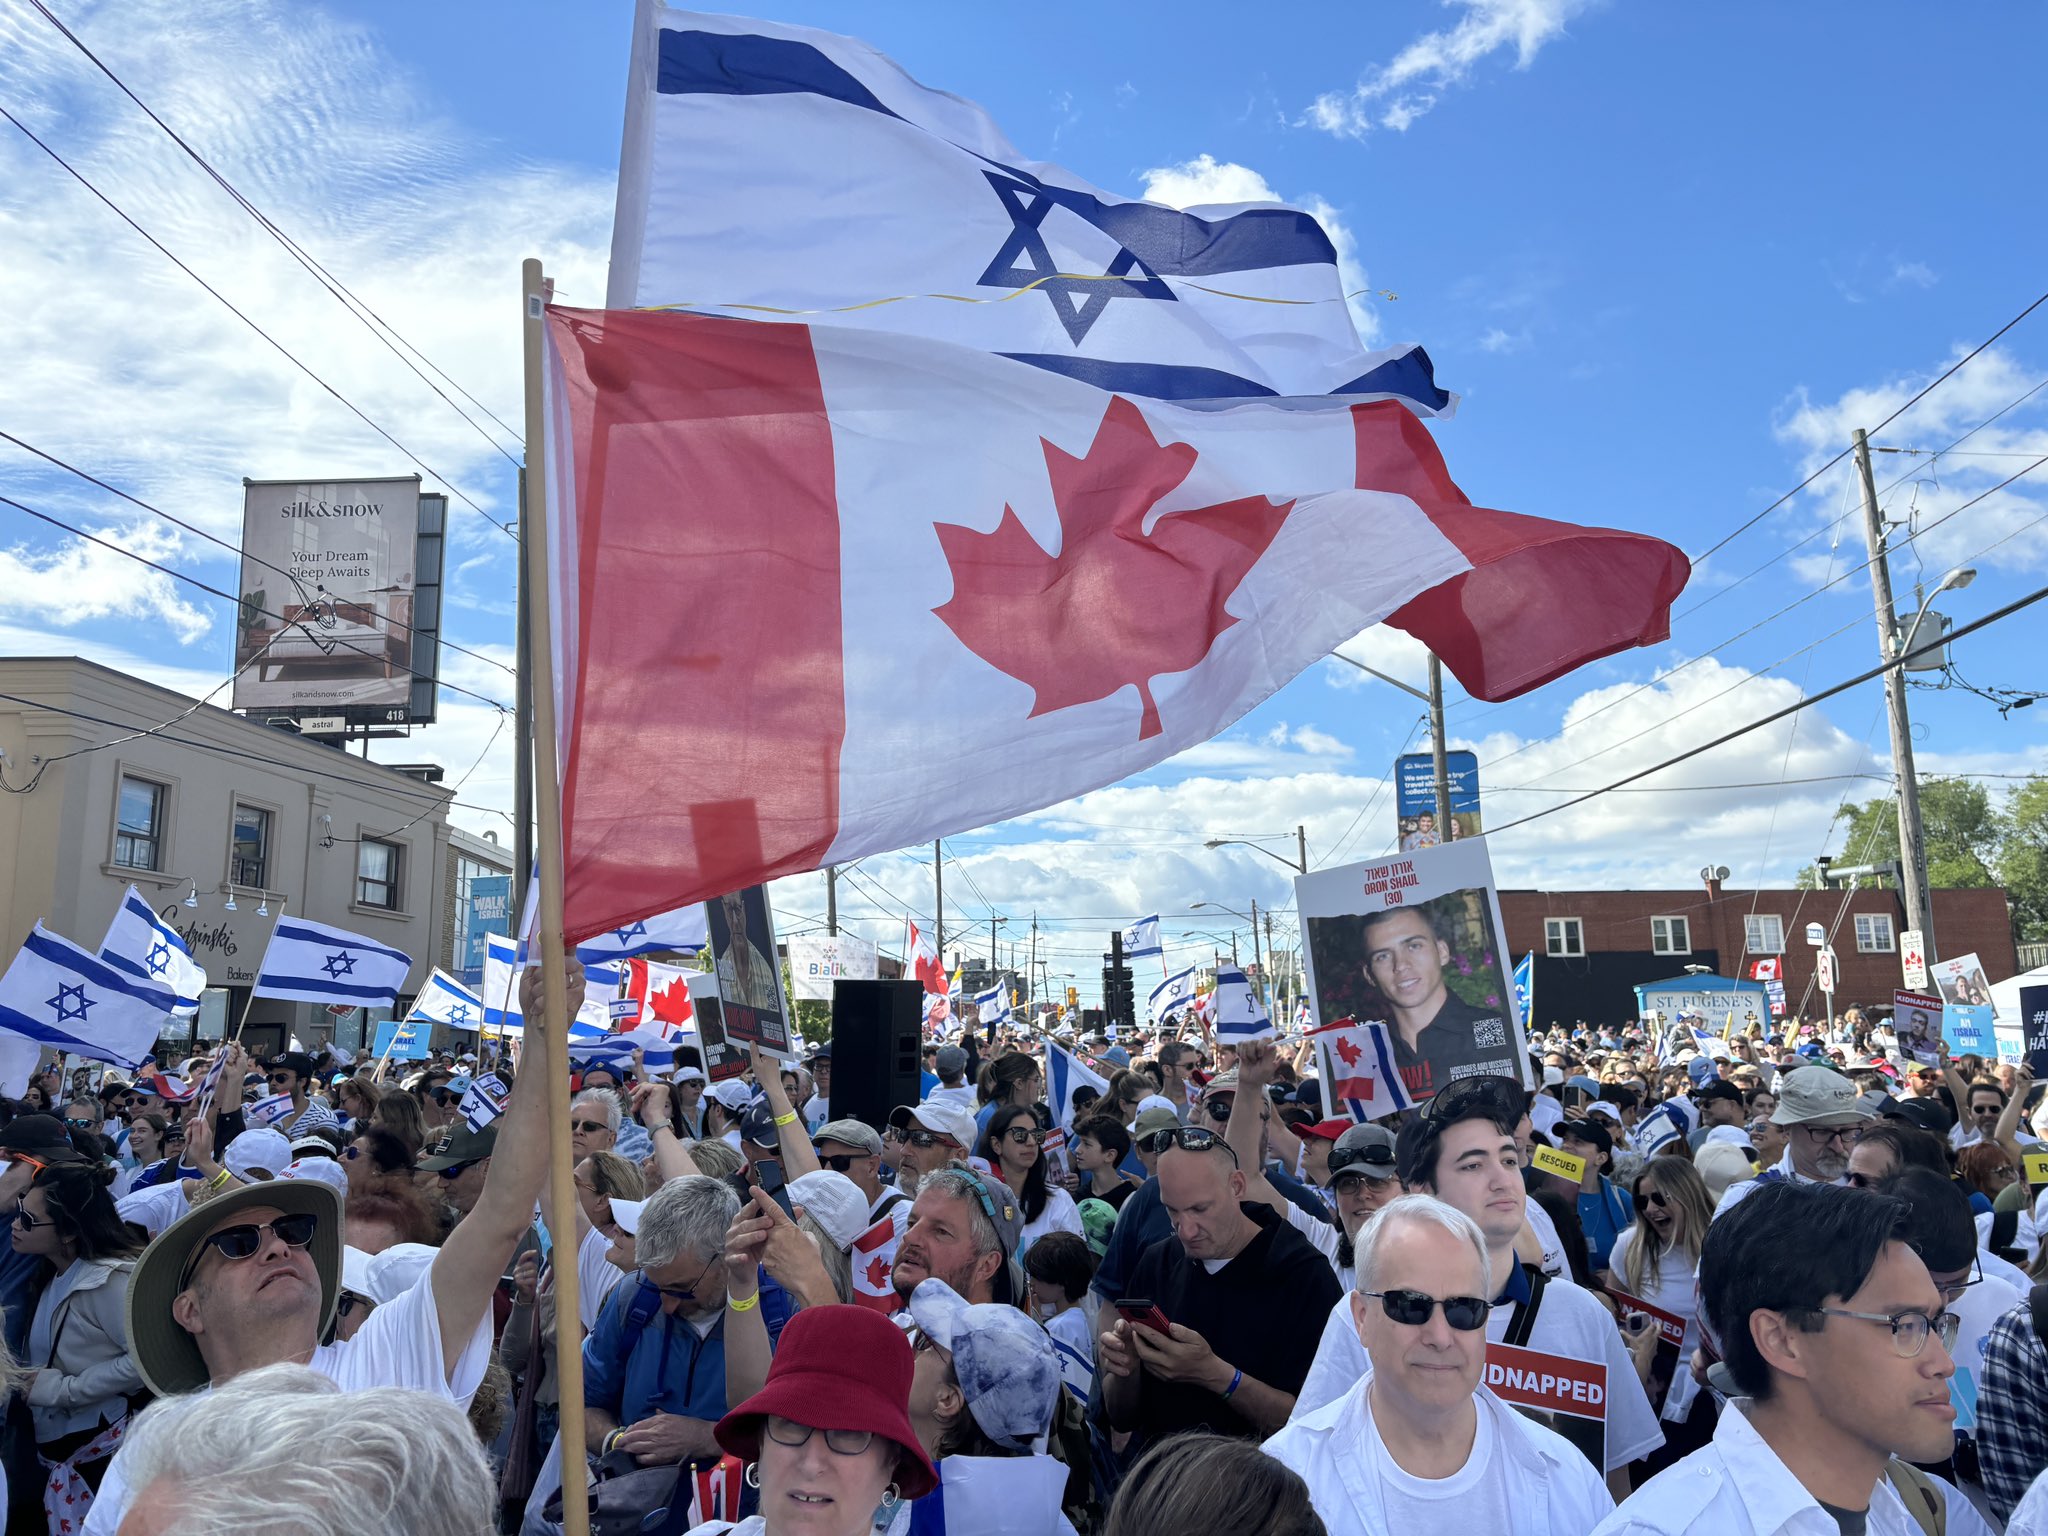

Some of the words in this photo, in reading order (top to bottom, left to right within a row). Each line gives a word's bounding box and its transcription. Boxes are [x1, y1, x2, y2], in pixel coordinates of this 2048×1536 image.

[281, 501, 384, 518] silk&snow
[292, 551, 322, 562] Your
[326, 551, 369, 561] Dream
[289, 567, 324, 580] Sleep
[327, 566, 370, 577] Awaits
[292, 690, 354, 699] silkandsnow.com
[386, 710, 404, 721] 418
[312, 721, 334, 729] astral
[1364, 880, 1388, 895] ORON
[1390, 873, 1420, 890] SHAUL
[473, 896, 506, 911] WALK
[1384, 890, 1403, 906] (30)
[479, 910, 506, 919] ISRAEL
[227, 967, 254, 980] Bakers
[809, 963, 847, 976] Bialik
[1657, 996, 1677, 1008] ST.
[1897, 995, 1942, 1009] KIDNAPPED
[1952, 1028, 1983, 1037] YISRAEL
[706, 1042, 726, 1056] BRING
[1450, 1063, 1477, 1074] HOSTAGES
[1477, 1062, 1489, 1071] AND
[1488, 1058, 1513, 1069] MISSING
[1540, 1152, 1577, 1173] RESCUED
[1480, 1362, 1604, 1405] IDNAPPED
